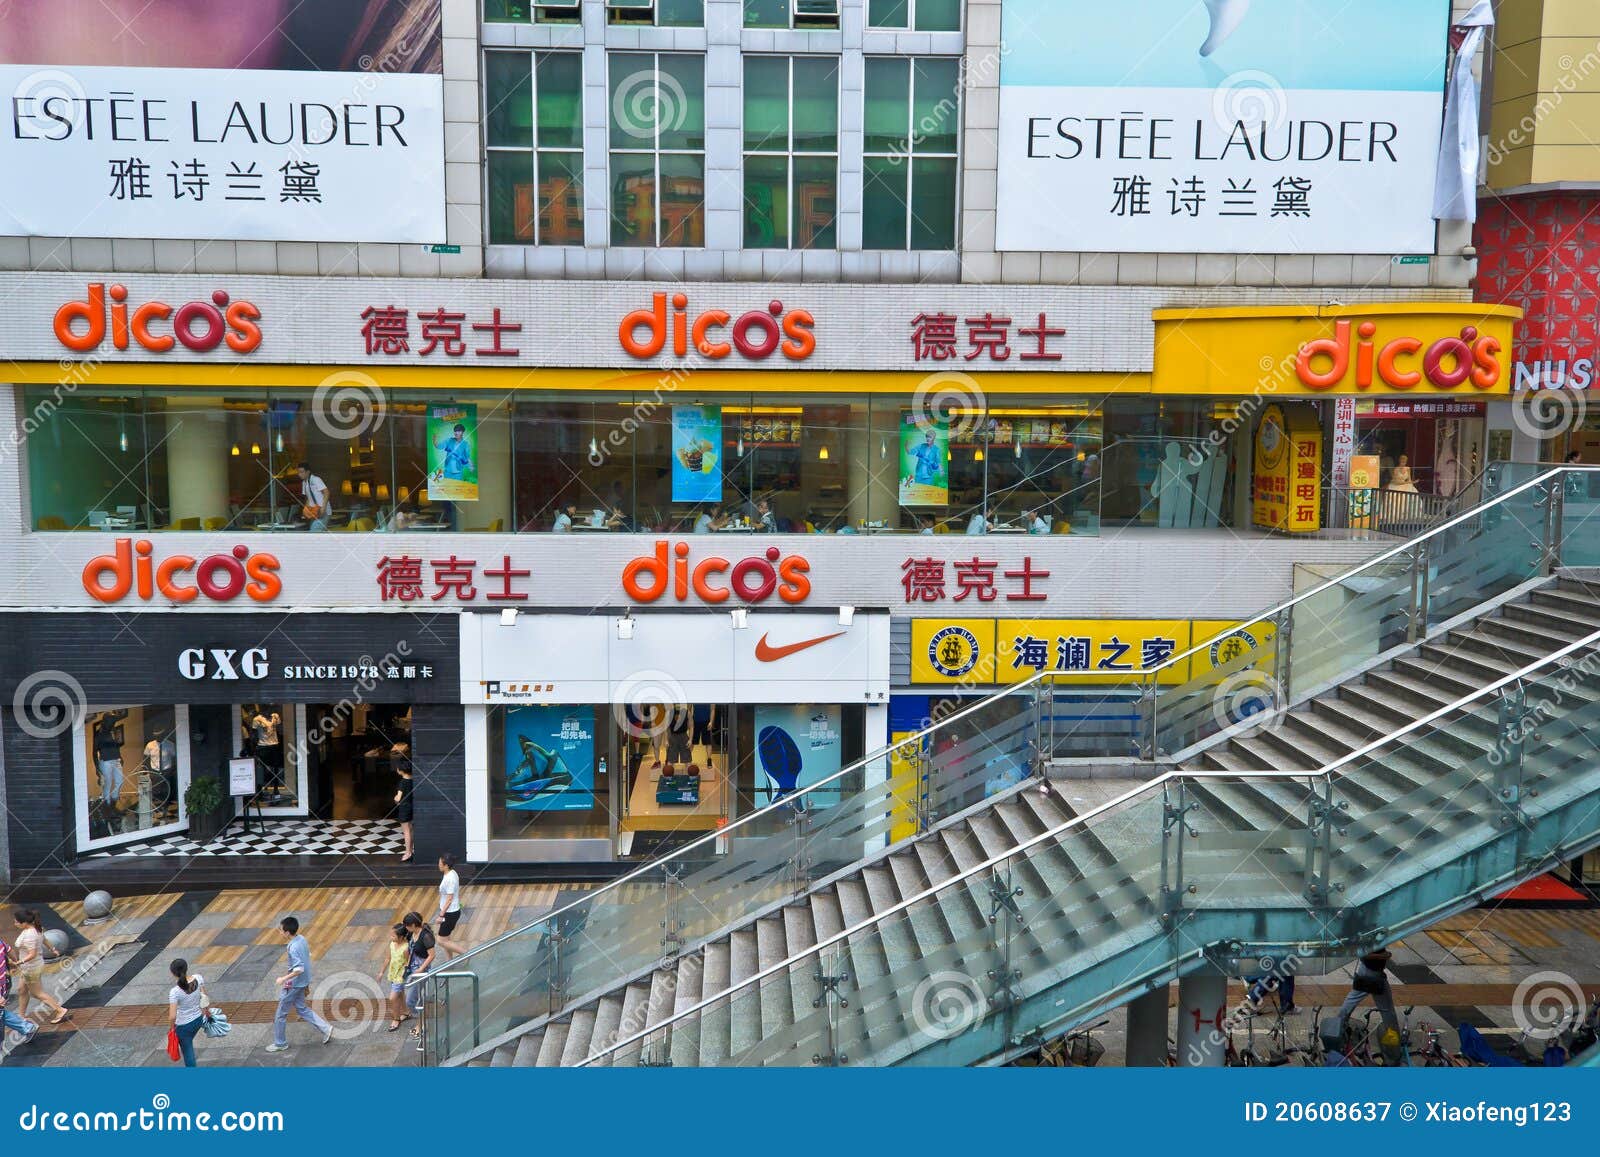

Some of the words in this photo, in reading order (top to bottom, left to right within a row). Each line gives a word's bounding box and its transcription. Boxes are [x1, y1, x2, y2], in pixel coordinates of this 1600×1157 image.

[192, 101, 407, 147] LAUDER
[1195, 120, 1397, 162] LAUDER
[108, 157, 322, 203] 雅诗兰黛
[1110, 175, 1313, 218] 雅诗兰黛
[360, 305, 522, 355] 德克士
[911, 312, 1065, 361] 德克士
[1336, 398, 1352, 443] 培训中心
[1296, 441, 1317, 522] 动漫电玩
[377, 555, 531, 601] 德克士
[901, 556, 1050, 602] 德克士
[178, 648, 269, 680] GXG
[387, 665, 433, 679] 杰斯卡
[1012, 636, 1177, 670] 海澜之家
